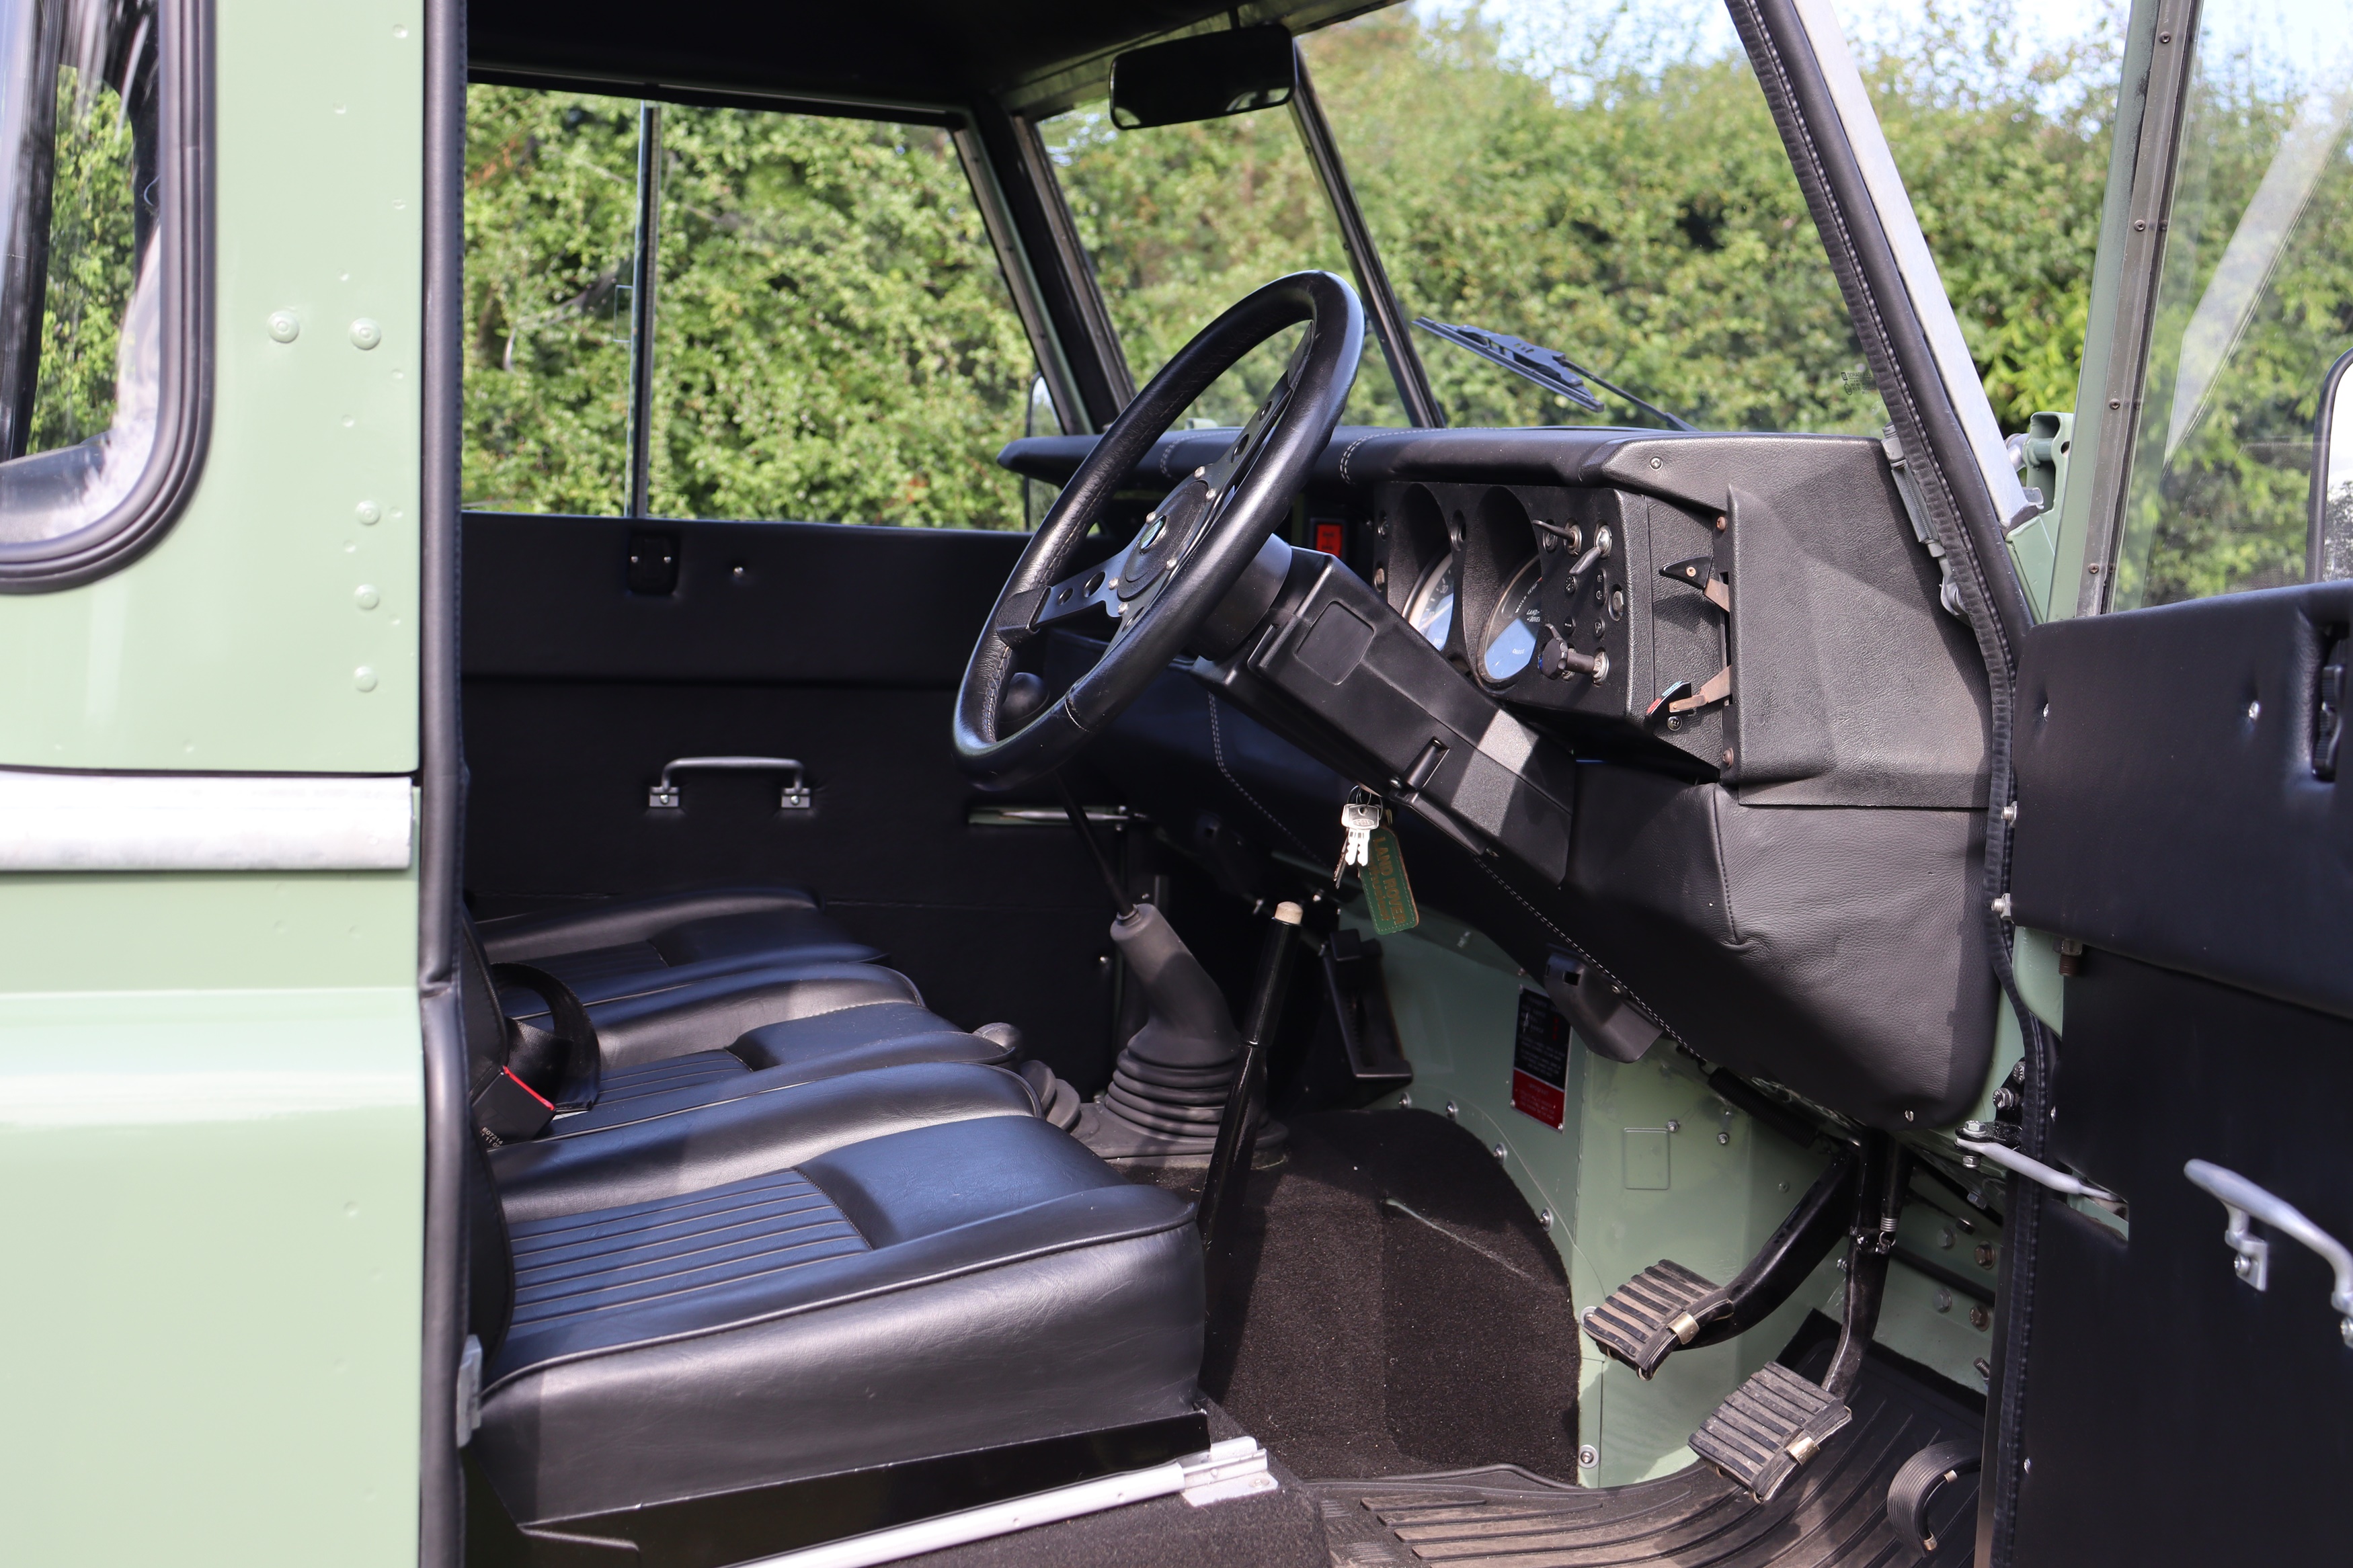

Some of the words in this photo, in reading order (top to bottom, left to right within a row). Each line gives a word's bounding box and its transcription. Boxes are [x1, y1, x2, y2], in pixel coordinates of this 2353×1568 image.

[1515, 596, 1527, 613] WATER
[1527, 583, 1538, 595] TEMP
[1372, 836, 1394, 876] LAND
[1383, 878, 1407, 925] ROVER
[482, 1126, 503, 1145] E07214
